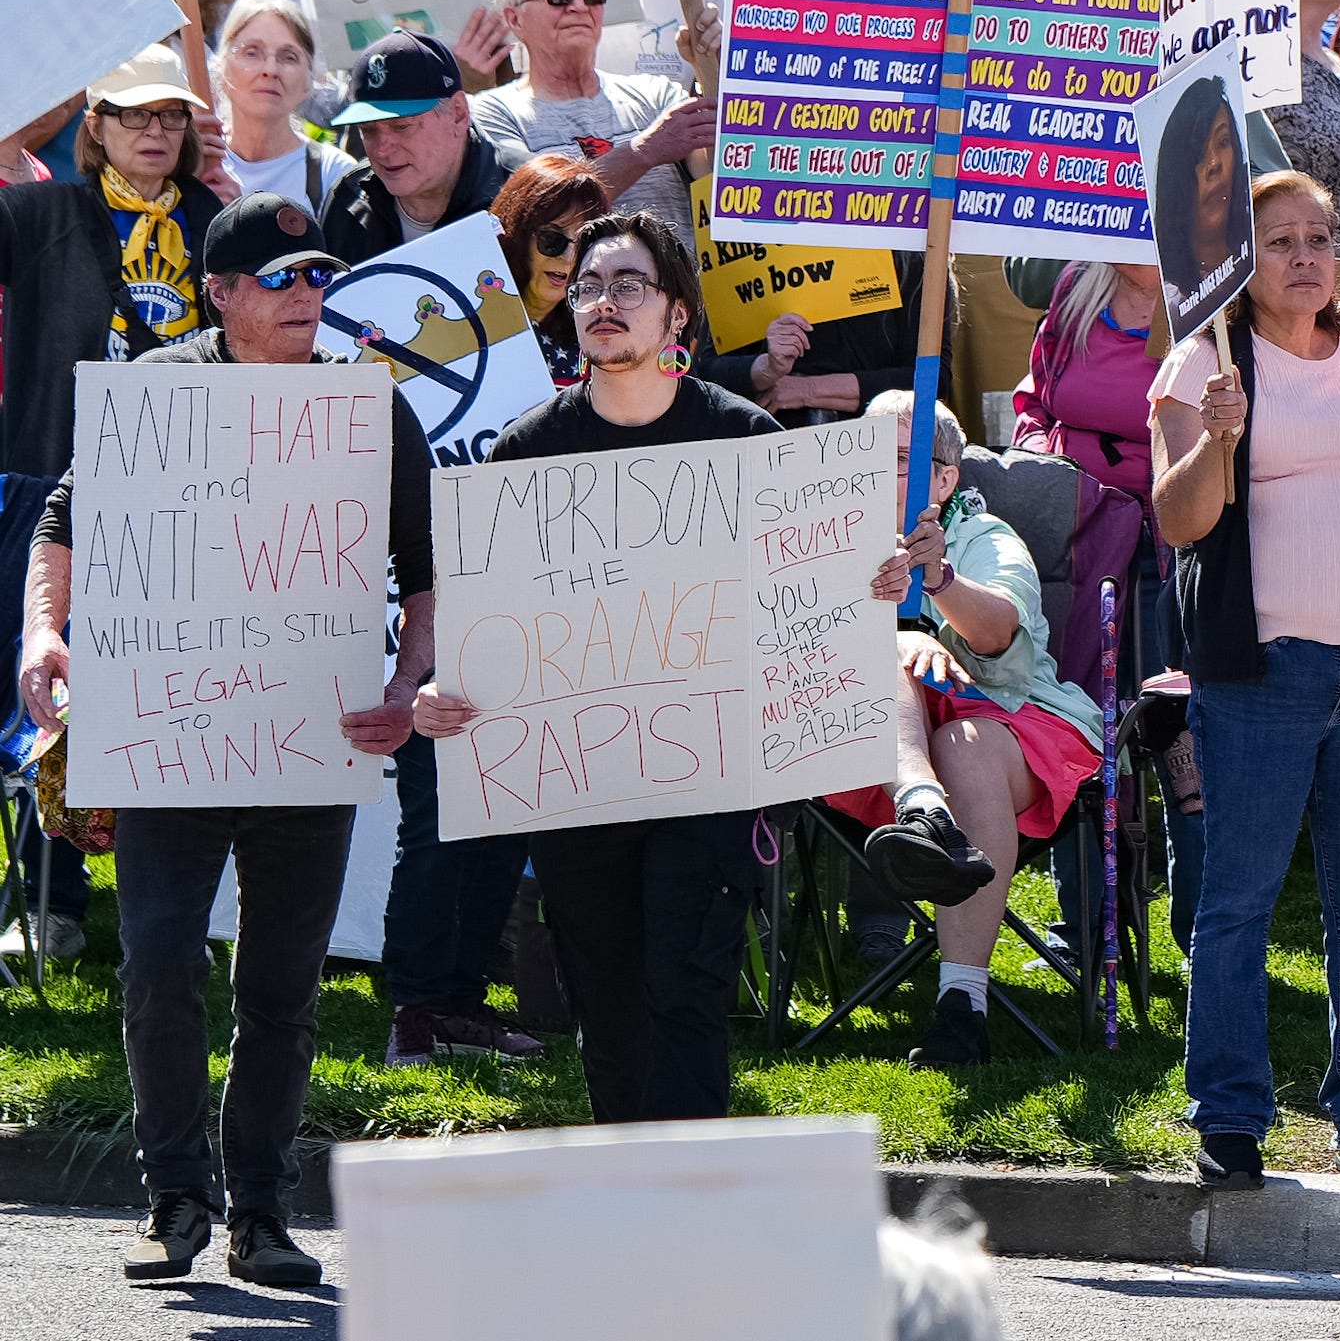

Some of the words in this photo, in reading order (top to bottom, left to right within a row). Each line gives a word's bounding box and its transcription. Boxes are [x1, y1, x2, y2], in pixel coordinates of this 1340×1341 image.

[735, 4, 799, 31] MURDERED
[802, 12, 827, 35] W/O
[836, 12, 862, 37] DUE
[866, 14, 916, 40] PROCESS
[974, 16, 999, 43] DO
[1007, 17, 1031, 45] TO
[1045, 20, 1109, 51] OTHERS
[1117, 26, 1159, 58] THEY
[731, 49, 746, 72] IN
[754, 48, 778, 74] the
[784, 53, 822, 79] LAND
[828, 55, 844, 78] of
[852, 55, 880, 84] THE
[970, 58, 1014, 90] WILL
[1027, 60, 1052, 92] do
[1064, 66, 1087, 96] to
[1100, 69, 1140, 99] YOU
[725, 98, 765, 129] NAZI
[790, 103, 861, 131] GESTAPO
[966, 100, 1012, 133] REAL
[1028, 104, 1106, 142] LEADERS
[722, 142, 755, 172] GET
[768, 145, 800, 174] THE
[807, 148, 846, 177] HELL
[851, 149, 885, 177] OUT
[961, 148, 1031, 178] COUNTRY
[1054, 156, 1108, 188] PEOPLE
[719, 185, 762, 215] OUR
[773, 189, 834, 220] CITIES
[957, 190, 1003, 221] PARTY
[1012, 195, 1034, 223] OR
[1043, 200, 1131, 233] REELECTION
[735, 279, 765, 305] we
[769, 259, 835, 295] bow
[767, 442, 795, 471] IF
[814, 425, 876, 460] YOU
[181, 468, 250, 503] and
[754, 470, 888, 523] SUPPORT
[442, 453, 741, 578] IMPRISON
[754, 509, 864, 566] TRUMP
[533, 559, 629, 597] THE
[756, 577, 818, 624] YOU
[88, 617, 202, 658] WHILE
[241, 615, 270, 649] IS
[285, 613, 368, 644] STILL
[458, 579, 742, 712] ORANGE
[756, 598, 864, 657] SUPPORT
[779, 635, 823, 661] THE
[761, 648, 838, 689] RAPE
[792, 670, 828, 691] AND
[134, 663, 288, 719] LEGAL
[761, 668, 865, 729] MURDER
[169, 713, 212, 732] TO
[761, 697, 895, 772] BABIES
[796, 708, 820, 725] OF
[471, 689, 744, 820] RAPIST
